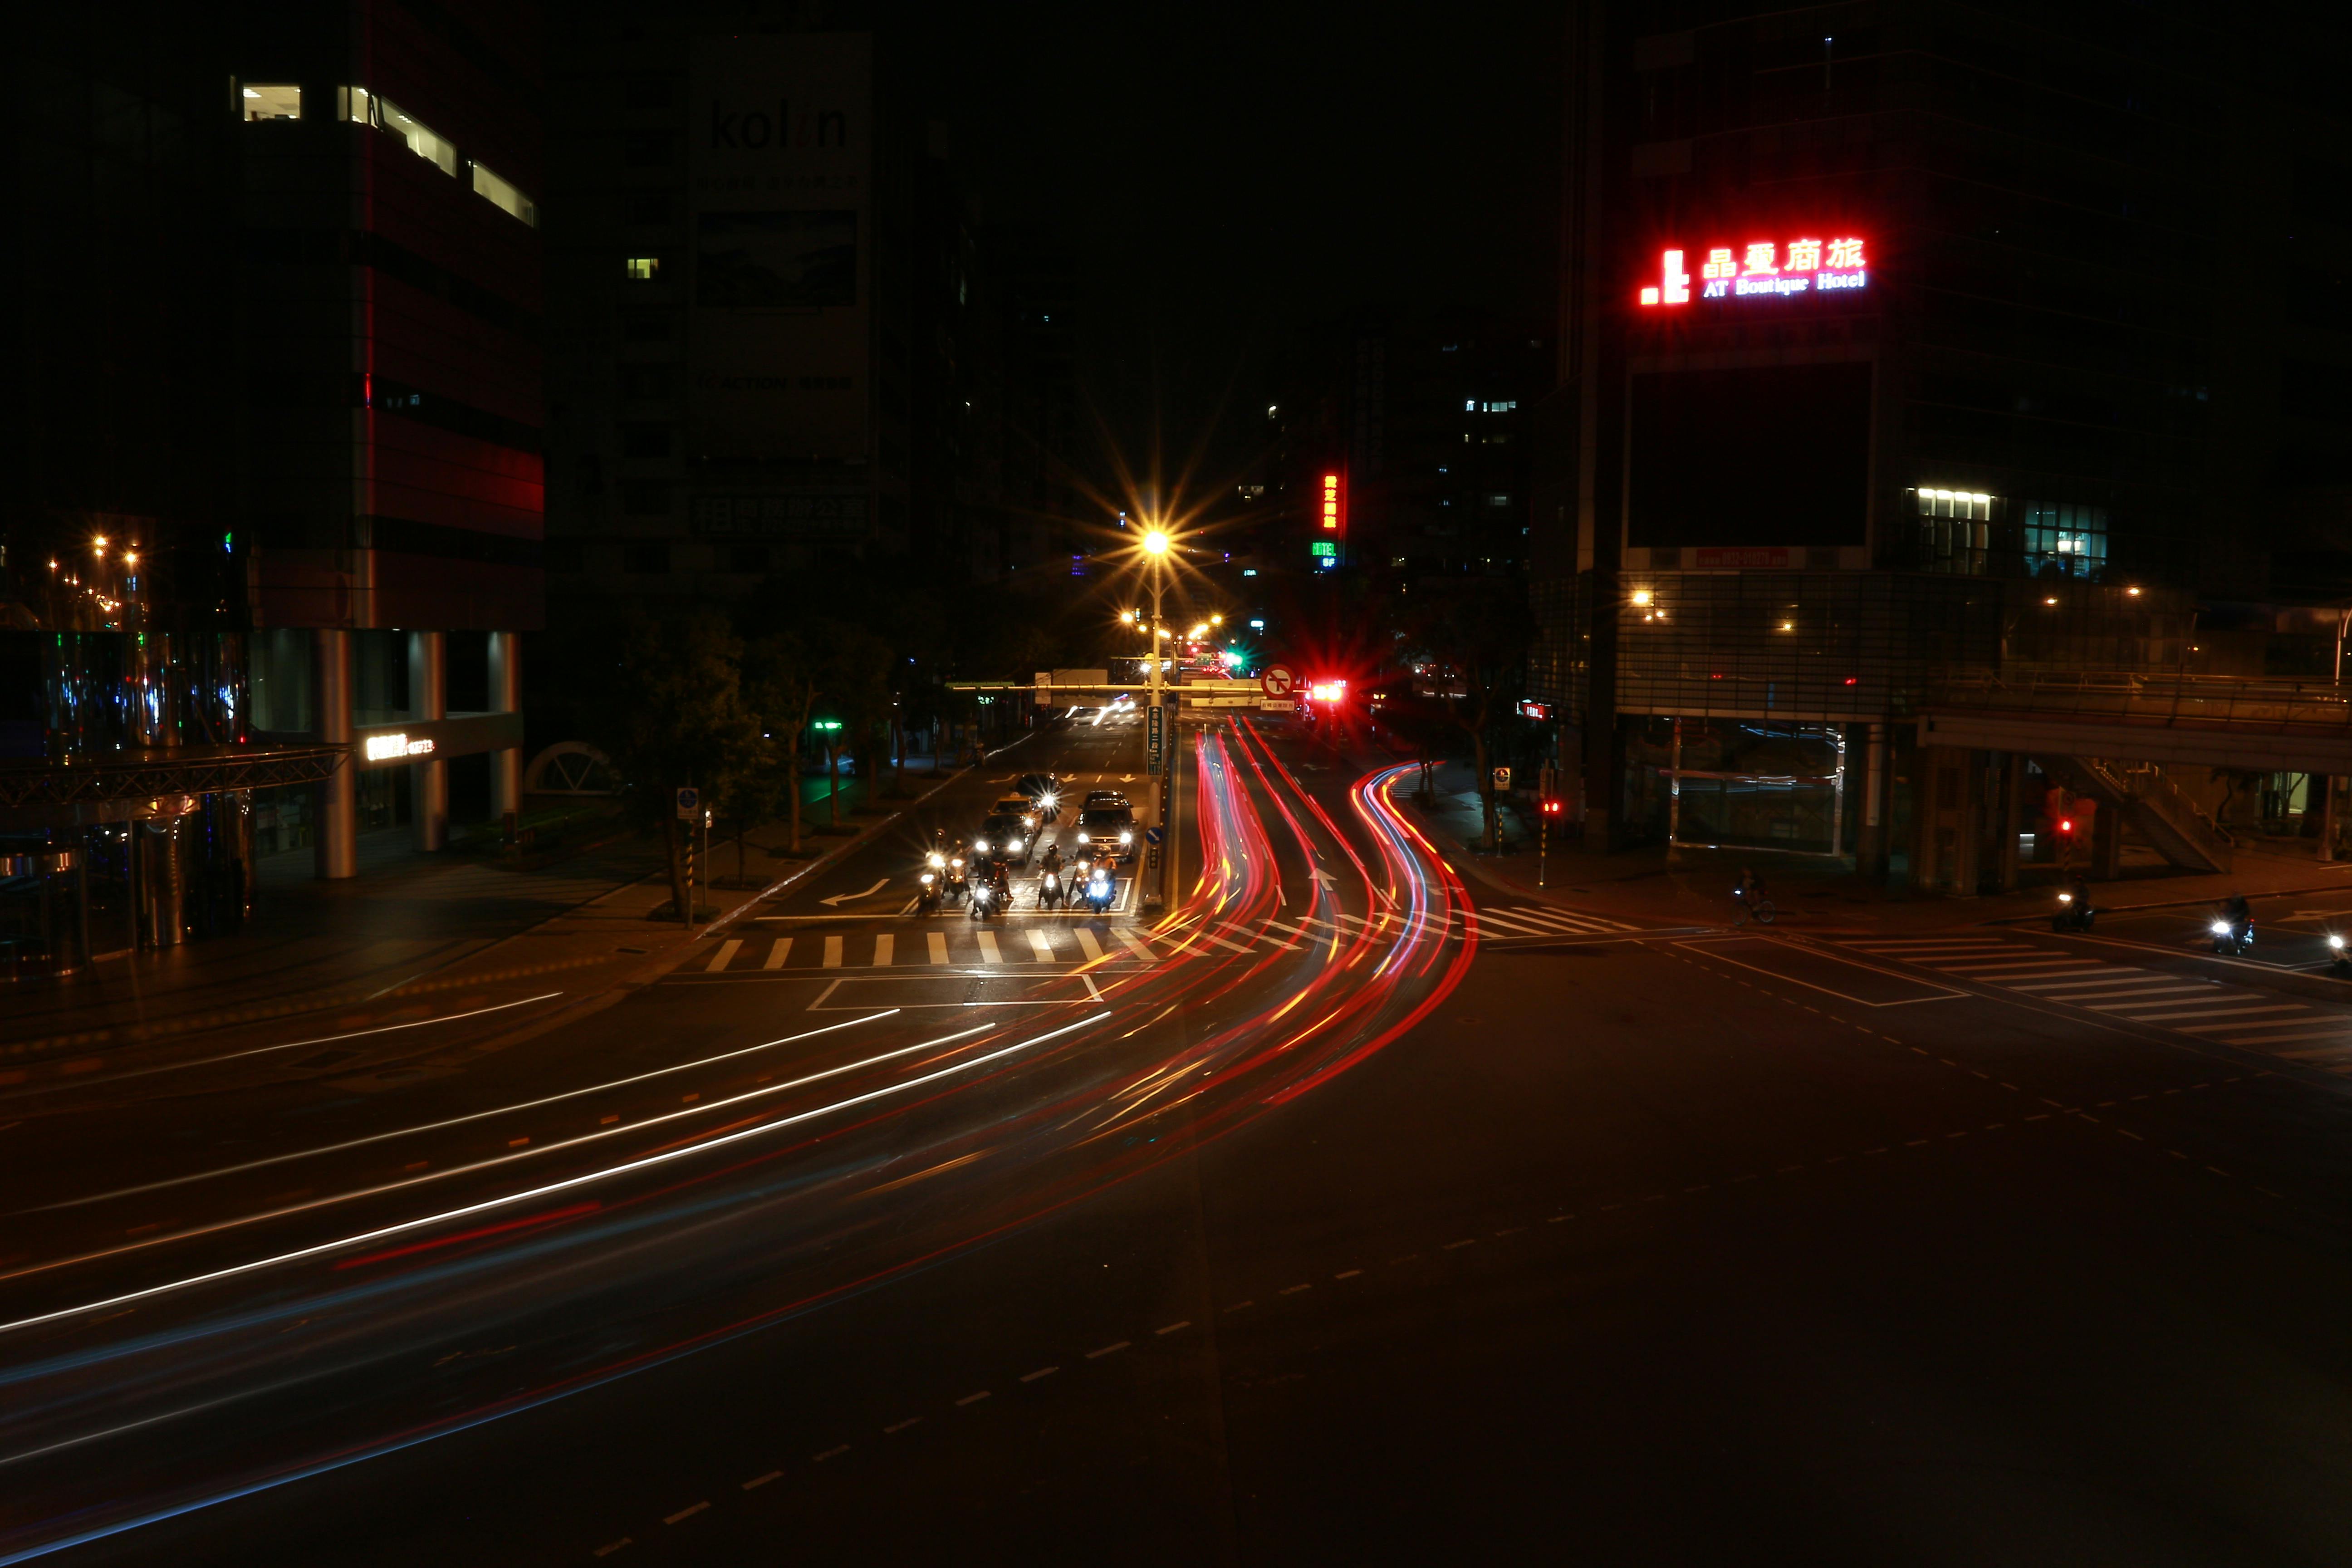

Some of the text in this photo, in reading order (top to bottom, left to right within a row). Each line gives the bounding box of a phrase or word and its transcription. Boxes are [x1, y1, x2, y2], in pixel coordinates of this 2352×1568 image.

[711, 98, 846, 149] kolin
[1703, 270, 1866, 298] AT Boutique Hotel
[694, 497, 733, 531] 租
[1312, 542, 1337, 557] HOTEL
